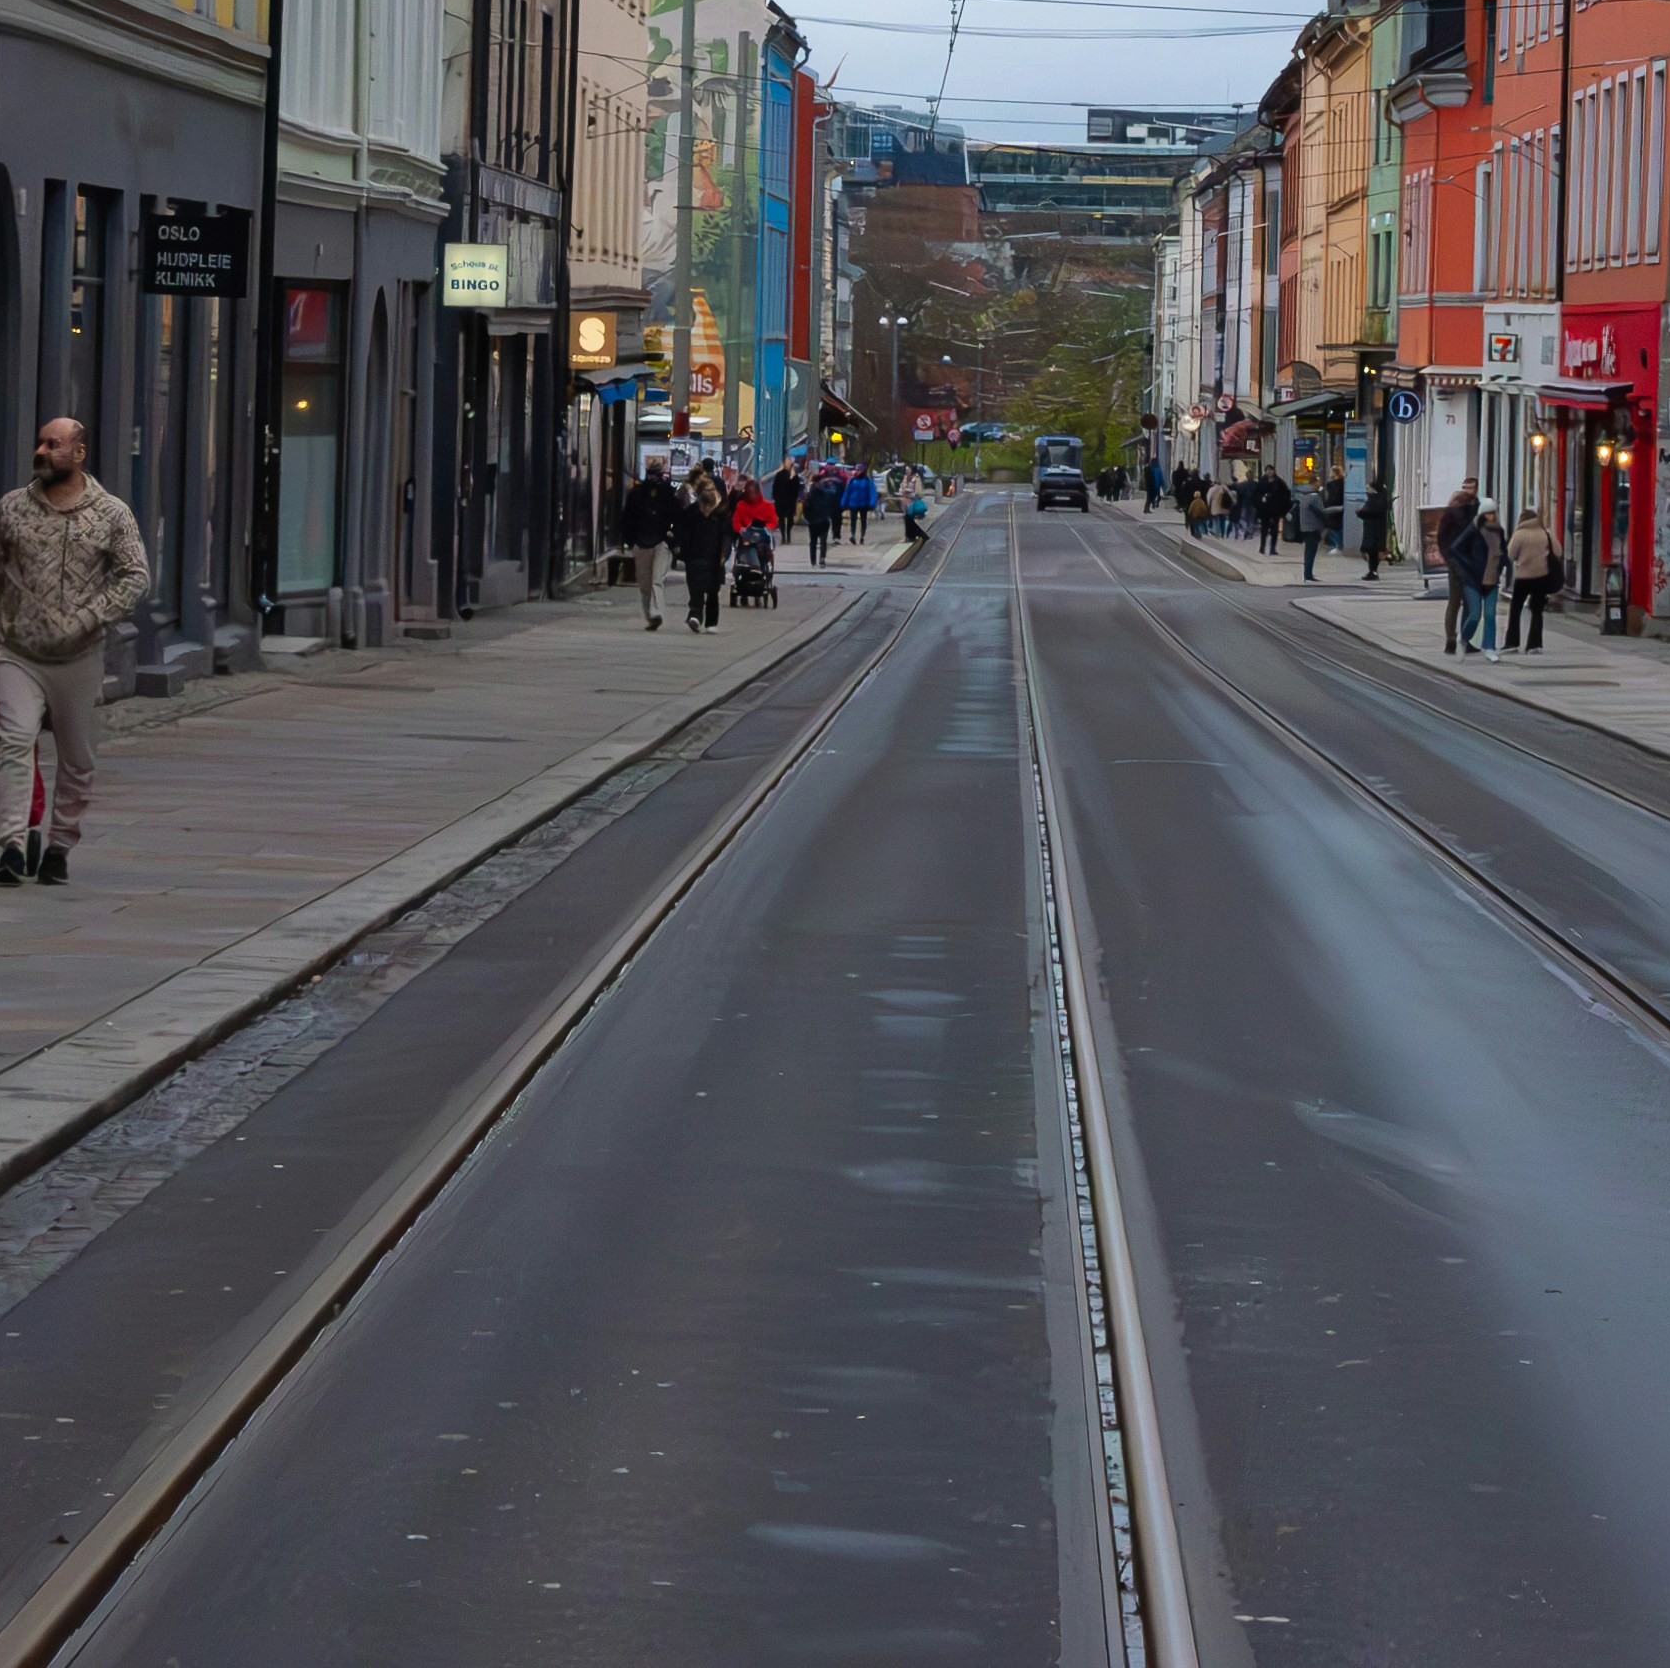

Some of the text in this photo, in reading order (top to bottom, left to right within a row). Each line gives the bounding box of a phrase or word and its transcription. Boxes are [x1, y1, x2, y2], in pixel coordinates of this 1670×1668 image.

[158, 225, 200, 241] OSLO
[157, 251, 232, 269] HUDPLEIE
[155, 271, 216, 288] KLINIKK
[450, 279, 499, 291] BINGO
